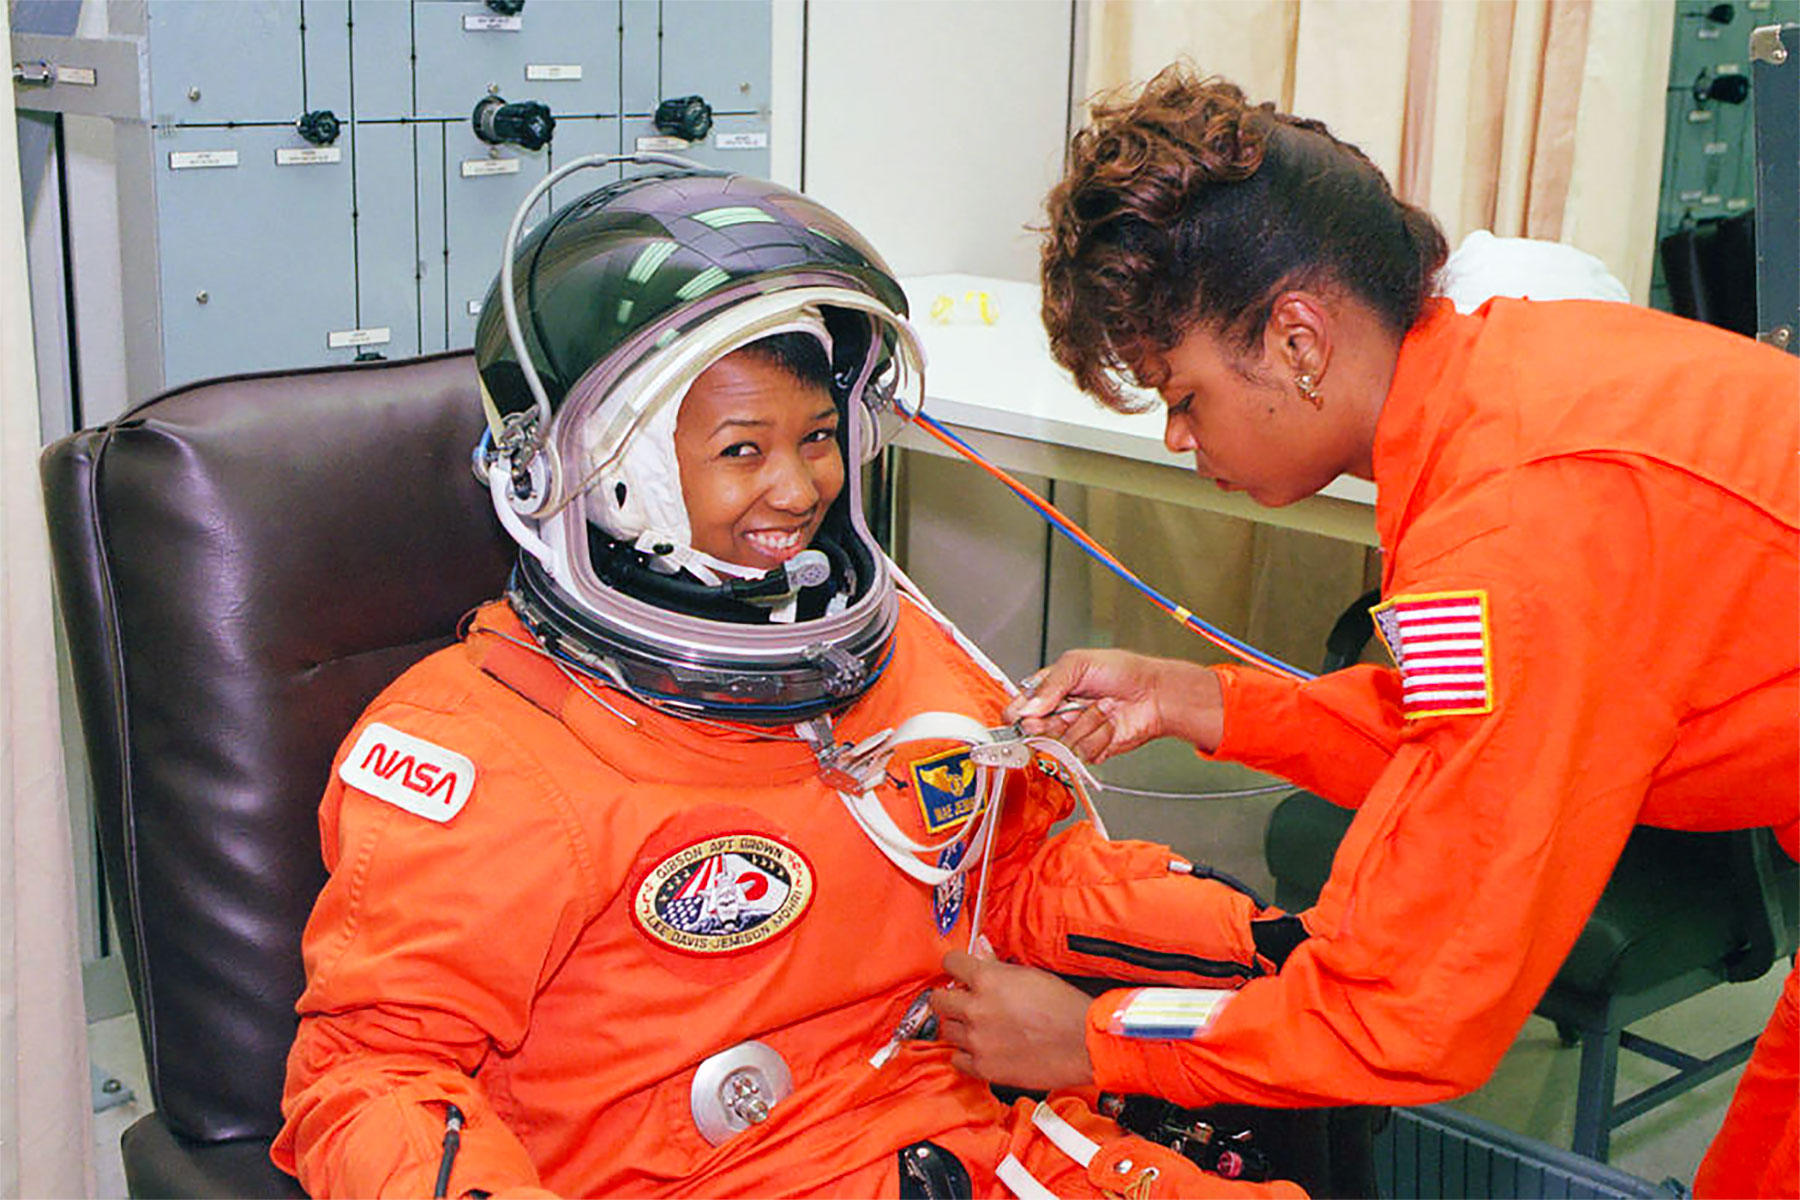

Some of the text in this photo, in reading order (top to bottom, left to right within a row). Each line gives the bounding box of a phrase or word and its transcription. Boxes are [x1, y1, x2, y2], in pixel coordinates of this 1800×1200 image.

[360, 743, 457, 804] NASA
[656, 837, 784, 879] GIBSON APT BROWN
[646, 890, 802, 949] LEE DAVIS JEMISON MOHRI
